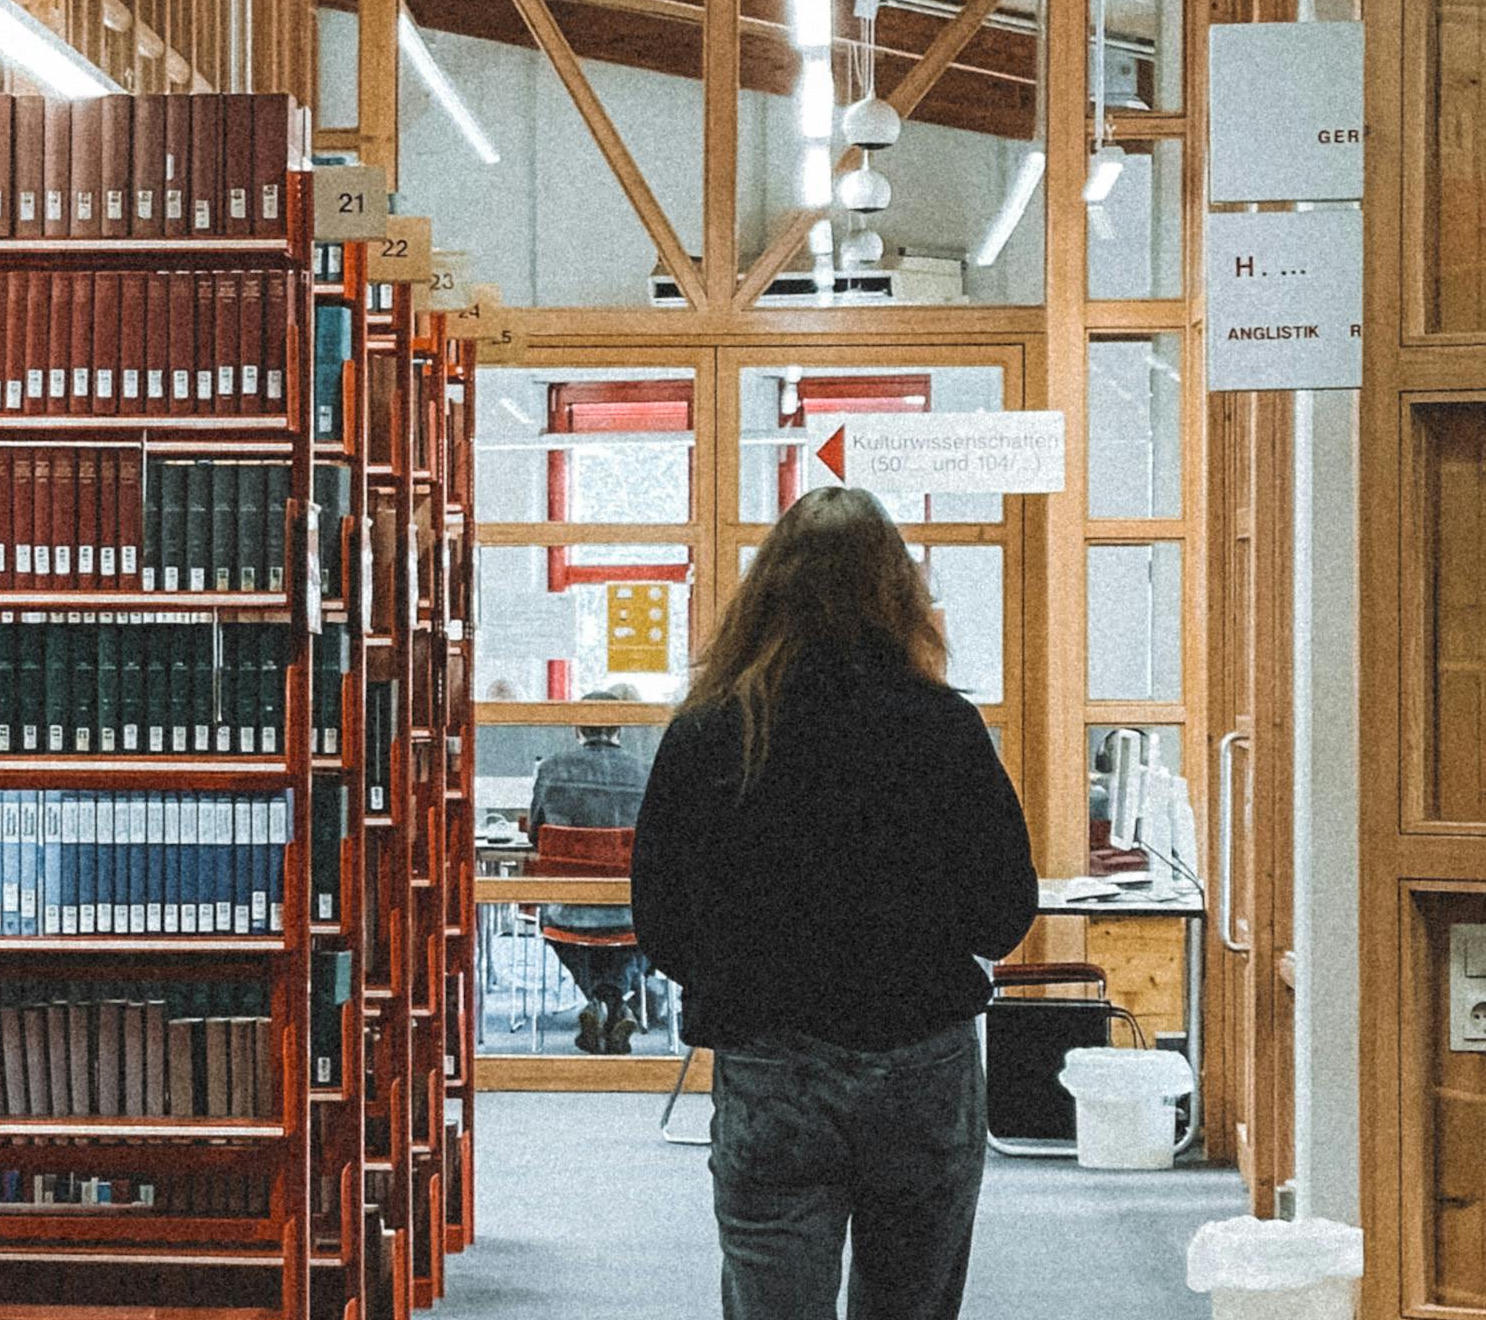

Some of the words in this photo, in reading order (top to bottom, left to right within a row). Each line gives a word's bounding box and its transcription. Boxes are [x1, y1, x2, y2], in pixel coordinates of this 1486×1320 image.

[1318, 130, 1360, 144] GER
[338, 193, 364, 213] 21
[381, 240, 408, 258] 22
[430, 274, 454, 290] 23
[1228, 325, 1319, 340] ANGLISTIK
[933, 455, 969, 473] und
